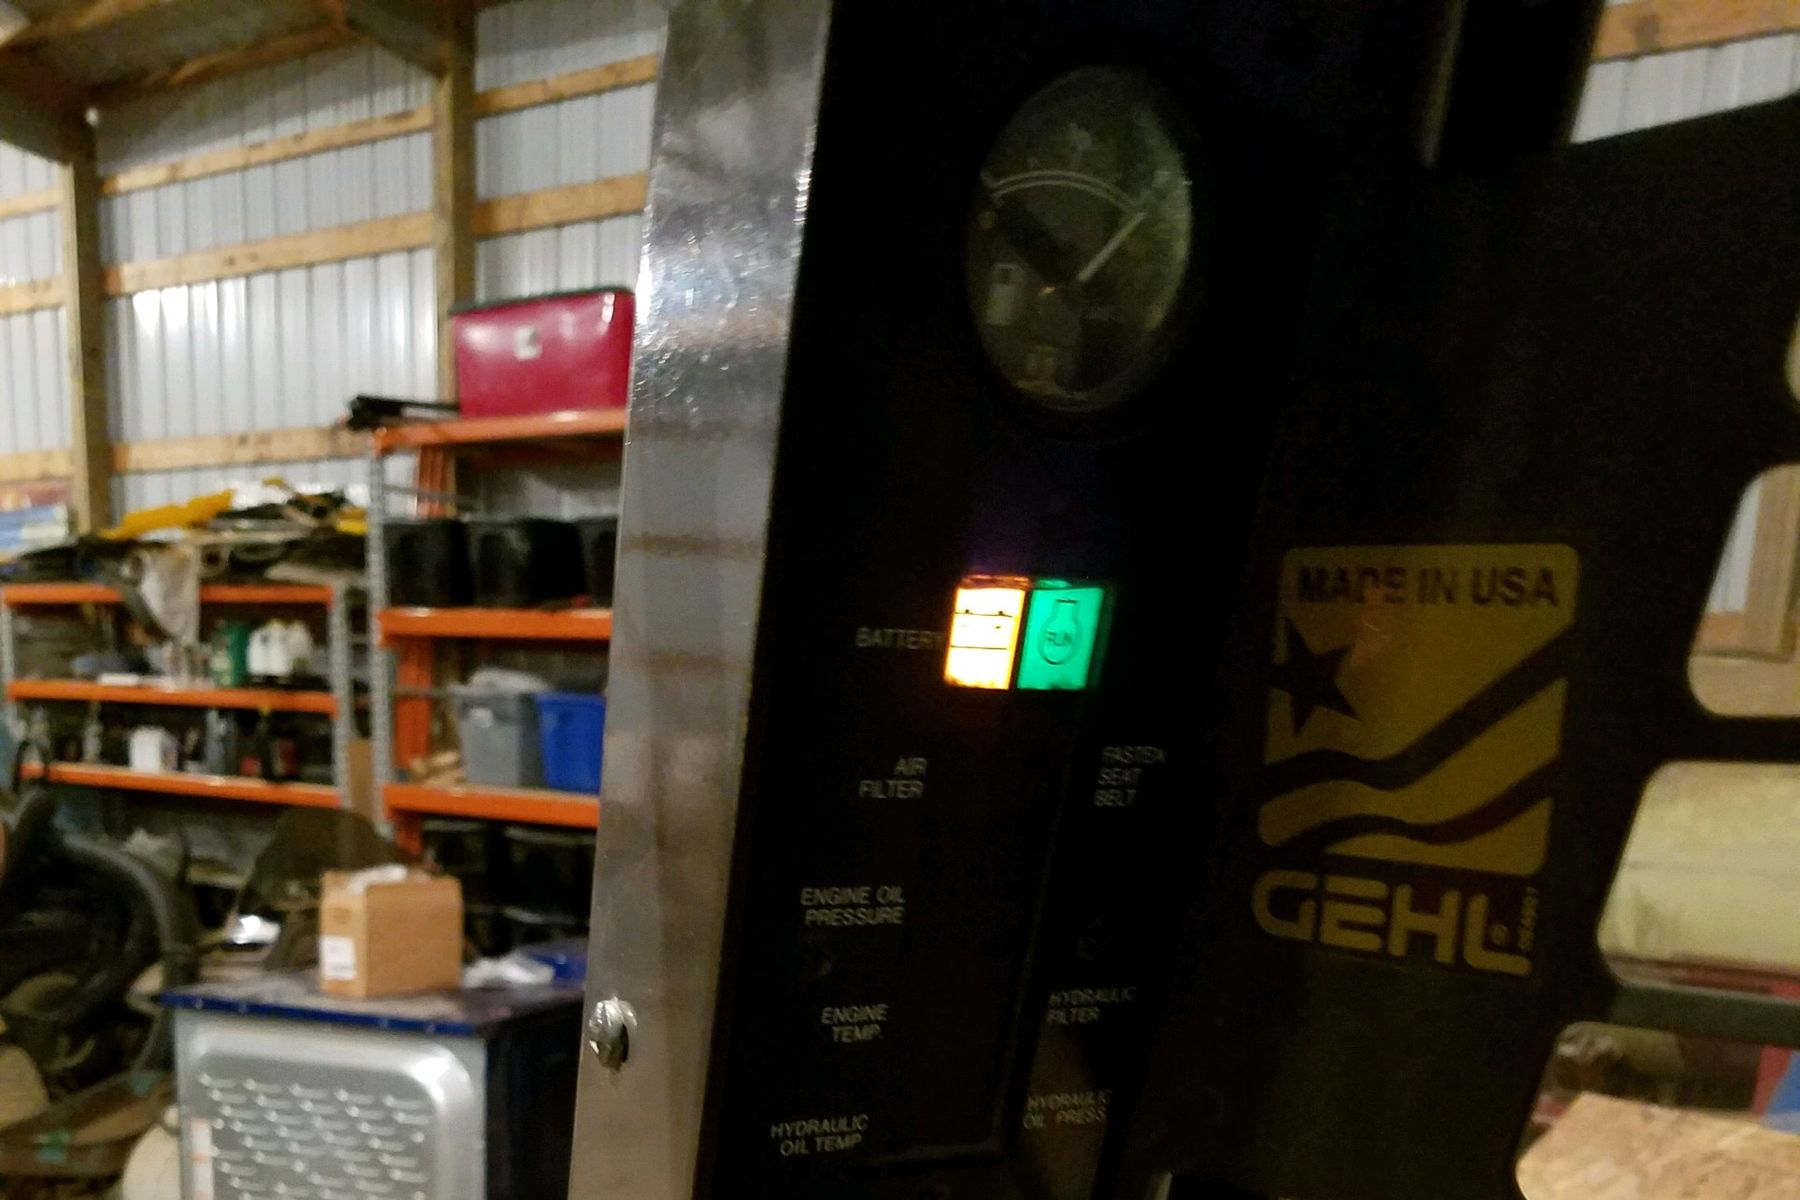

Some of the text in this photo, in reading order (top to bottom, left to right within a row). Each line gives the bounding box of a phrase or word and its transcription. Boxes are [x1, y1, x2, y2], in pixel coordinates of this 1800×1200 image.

[1300, 566, 1558, 606] MADE IN USA
[855, 626, 946, 650] BATTER
[893, 756, 928, 777] AIR
[858, 779, 925, 800] FILTER
[1092, 788, 1137, 807] BELT
[801, 884, 906, 906] ENGINE OIL
[804, 906, 905, 928] PRESSURE
[1252, 869, 1533, 977] GEHL
[821, 1003, 889, 1025] ENGINE
[770, 1113, 870, 1139] HYDRAULIC
[779, 1138, 810, 1157] OIL
